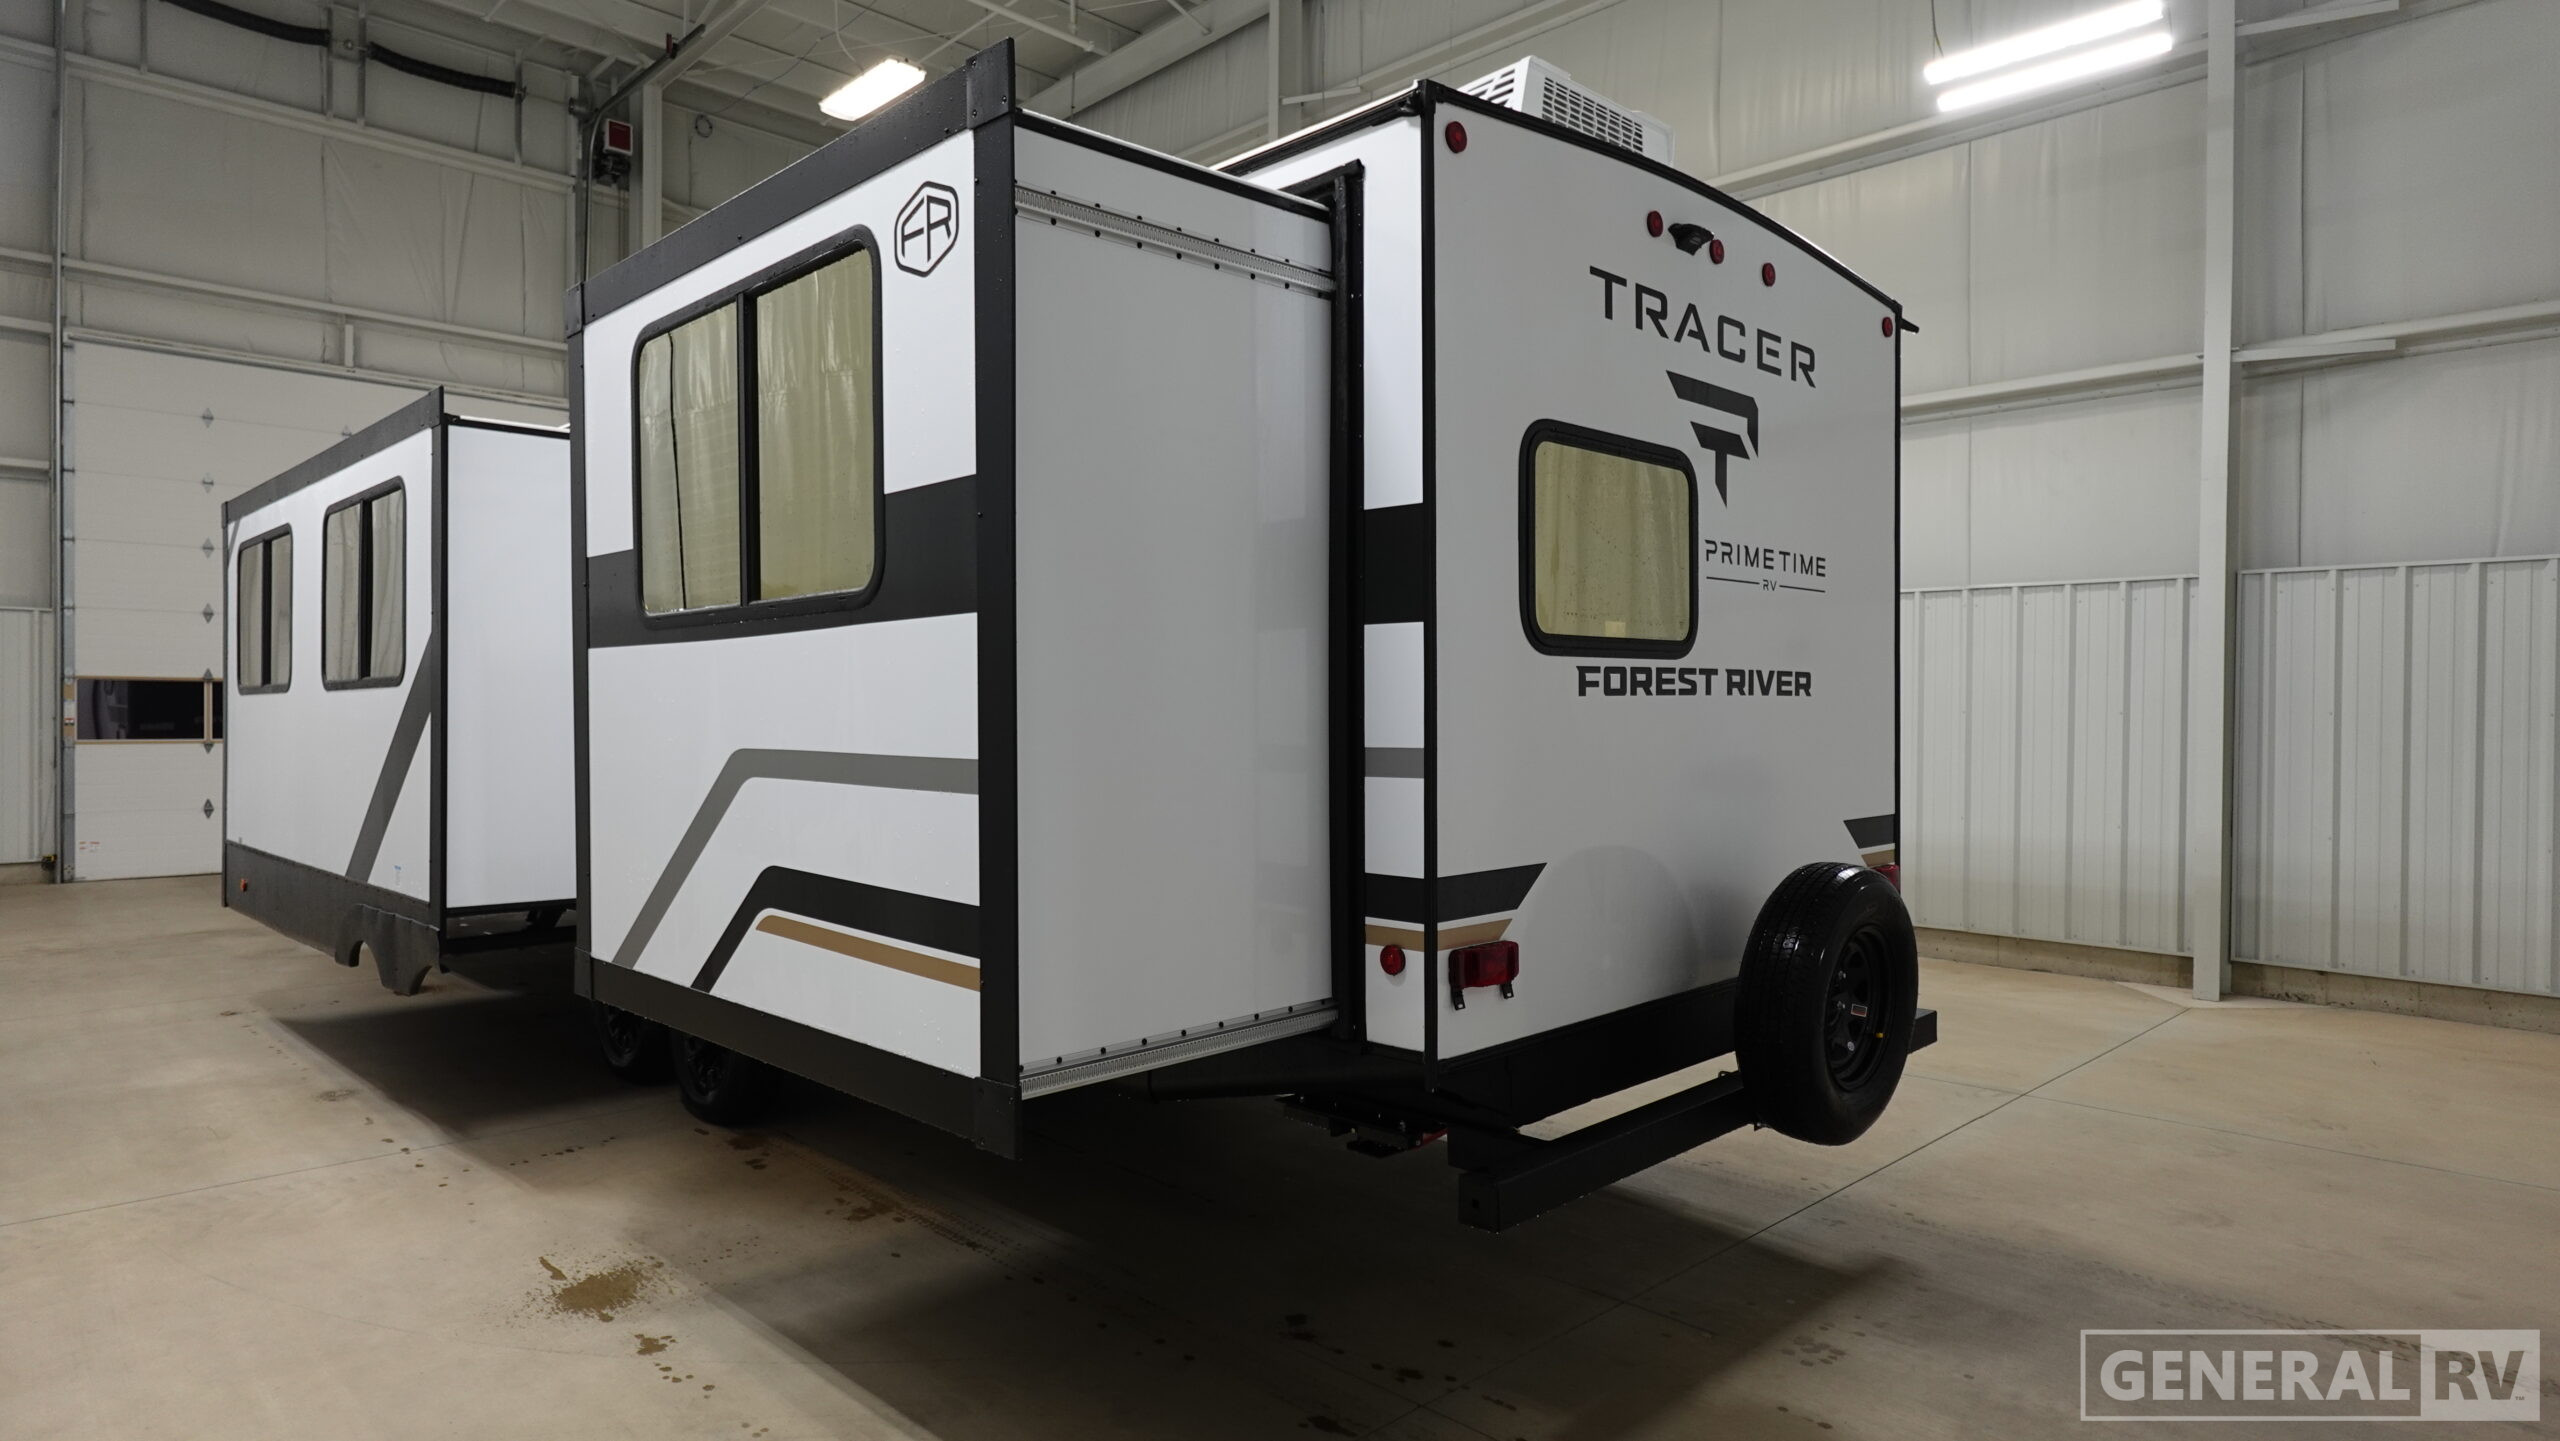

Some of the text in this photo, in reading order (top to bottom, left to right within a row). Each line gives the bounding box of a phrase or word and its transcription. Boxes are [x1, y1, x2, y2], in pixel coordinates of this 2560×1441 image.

[1589, 265, 1816, 388] TRACER
[1762, 579, 1777, 591] RV
[1576, 665, 1811, 697] FOREST RIVER
